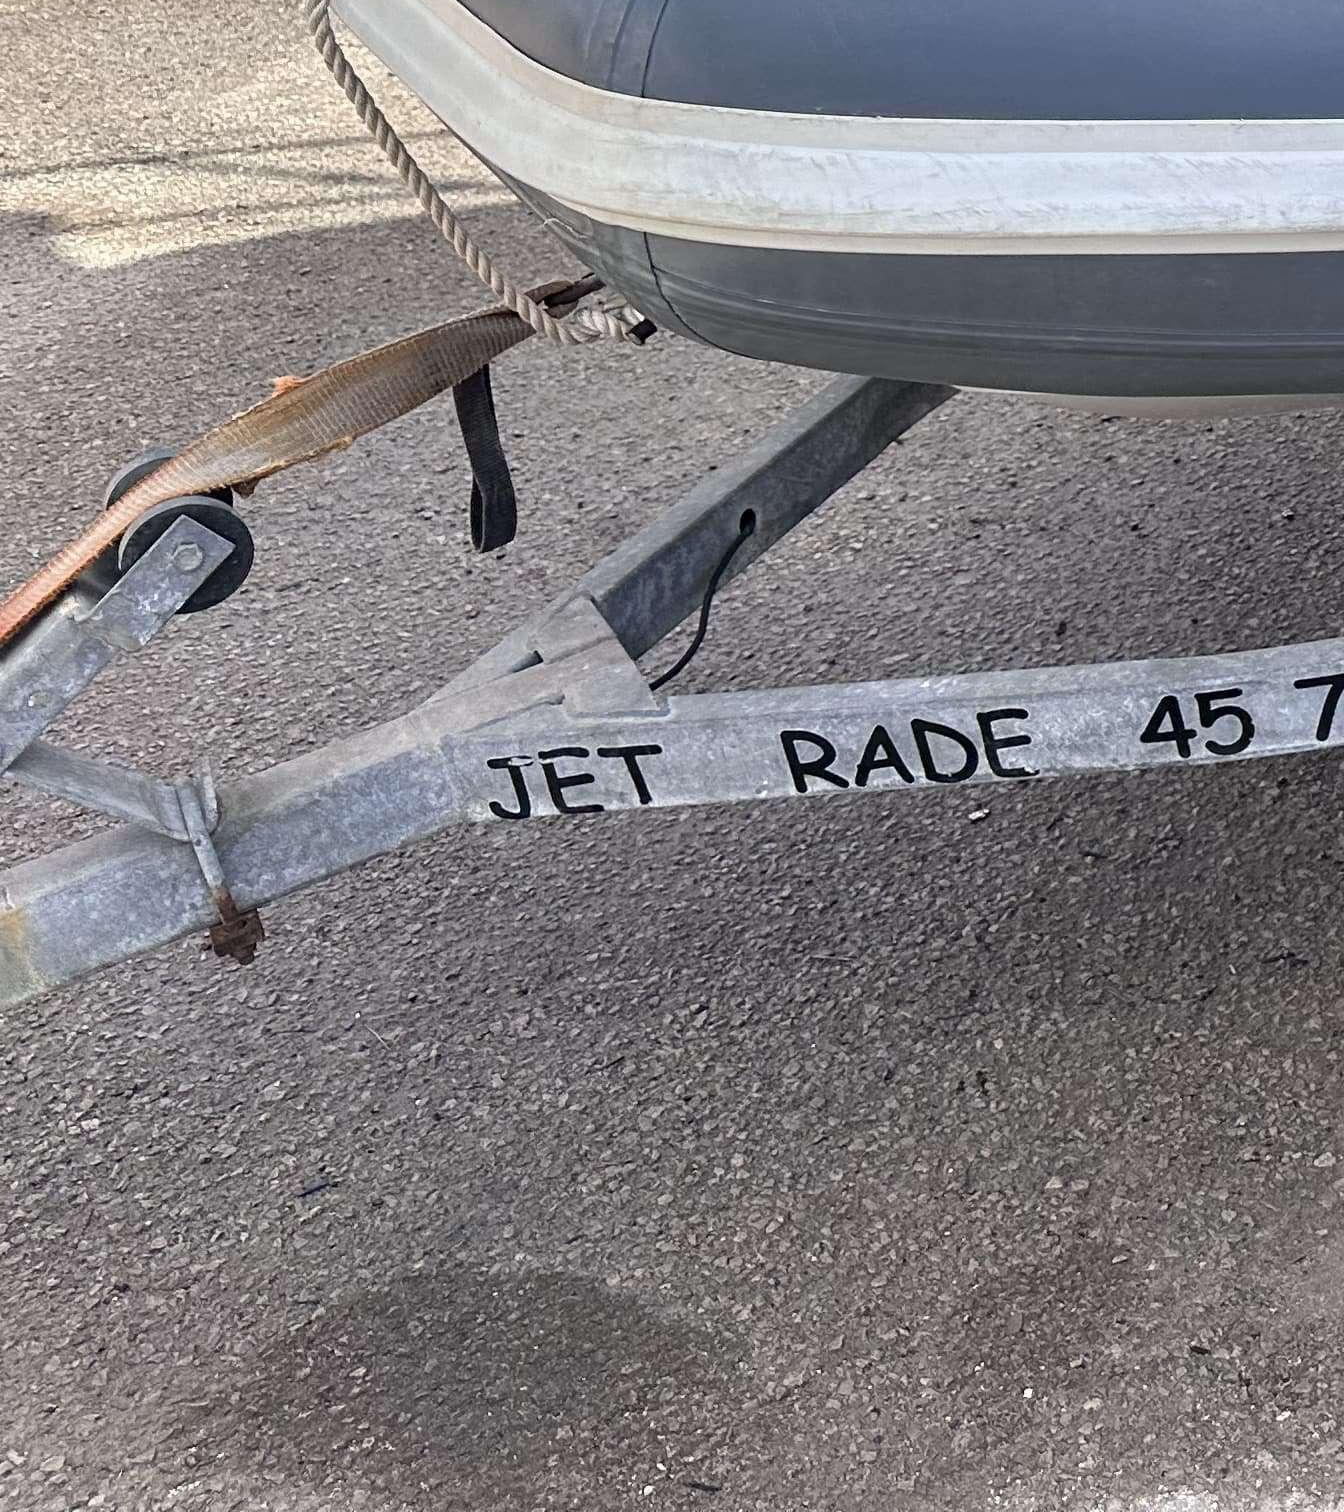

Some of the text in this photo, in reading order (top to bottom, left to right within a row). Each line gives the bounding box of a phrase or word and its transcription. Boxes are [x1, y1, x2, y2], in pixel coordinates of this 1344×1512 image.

[487, 743, 663, 820] JET
[779, 707, 1040, 794] RADE
[1139, 687, 1256, 759] 45
